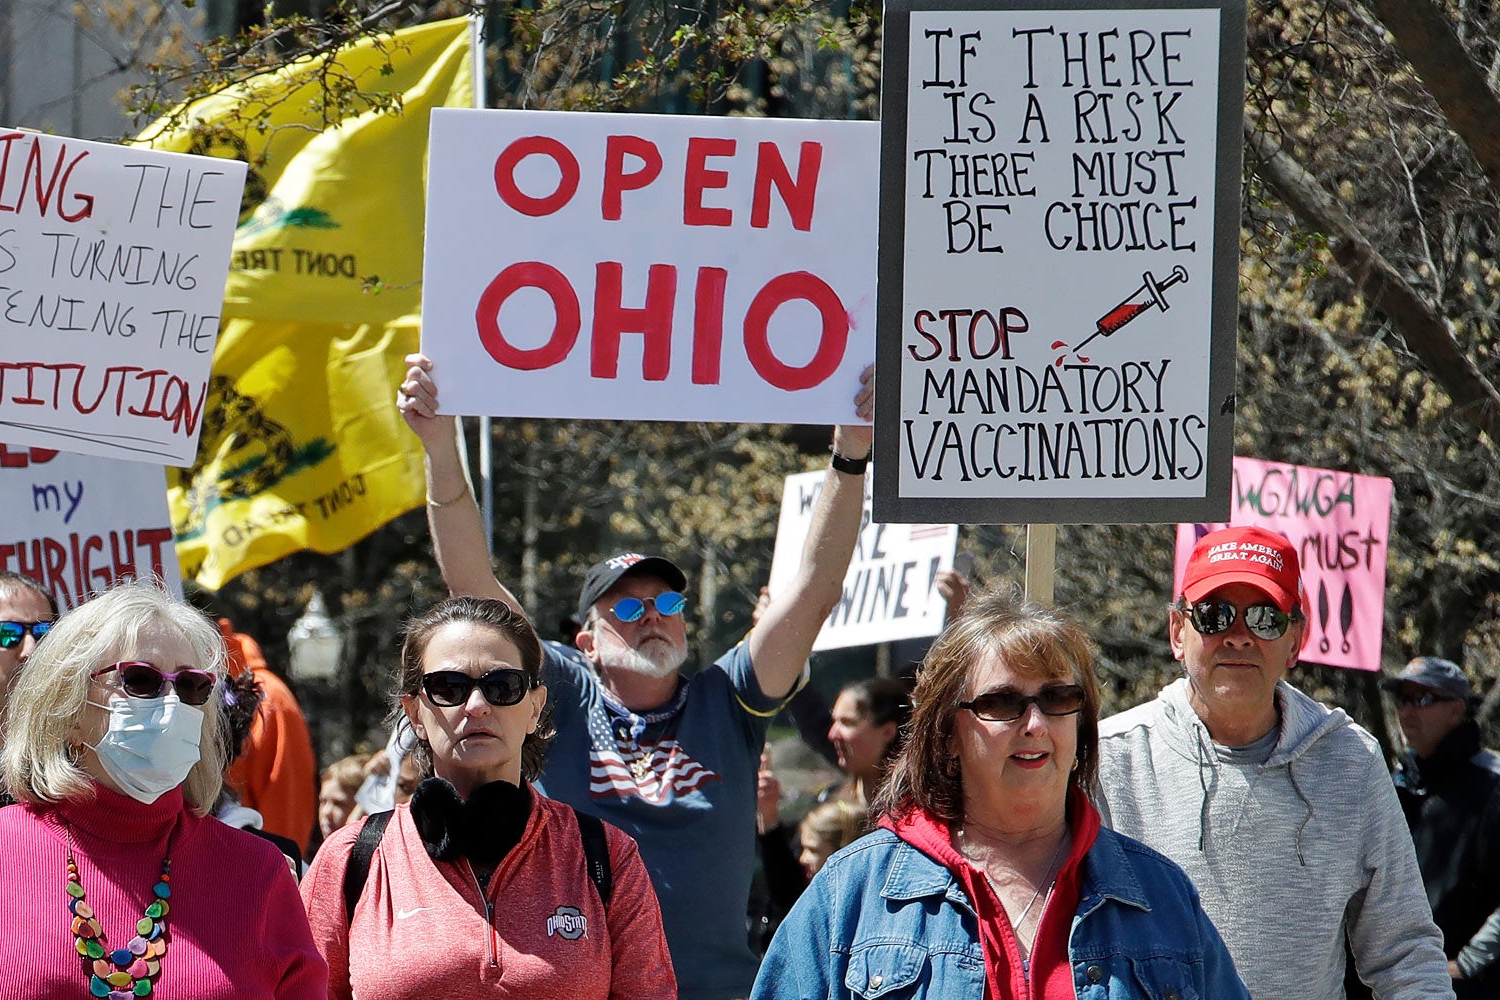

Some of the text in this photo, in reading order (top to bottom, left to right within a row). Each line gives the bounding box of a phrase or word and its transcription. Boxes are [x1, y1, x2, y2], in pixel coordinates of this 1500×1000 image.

[922, 25, 1194, 90] IF THERE
[943, 90, 1186, 145] IS A RISK
[125, 164, 224, 229] THE
[494, 135, 823, 232] OPEN
[914, 149, 1186, 199] THERE MUST
[942, 196, 1198, 254] BE CHOICE
[42, 232, 198, 290] TURNING
[151, 310, 219, 353] THE
[475, 260, 850, 392] OHIO
[907, 307, 1029, 362] STOP
[919, 360, 1171, 415] MANDATORY
[903, 415, 1207, 482] VACCINATIONS
[32, 480, 83, 524] my
[1208, 542, 1283, 566] MAKE AMERICA
[1210, 552, 1283, 572] GREAT AGAIN
